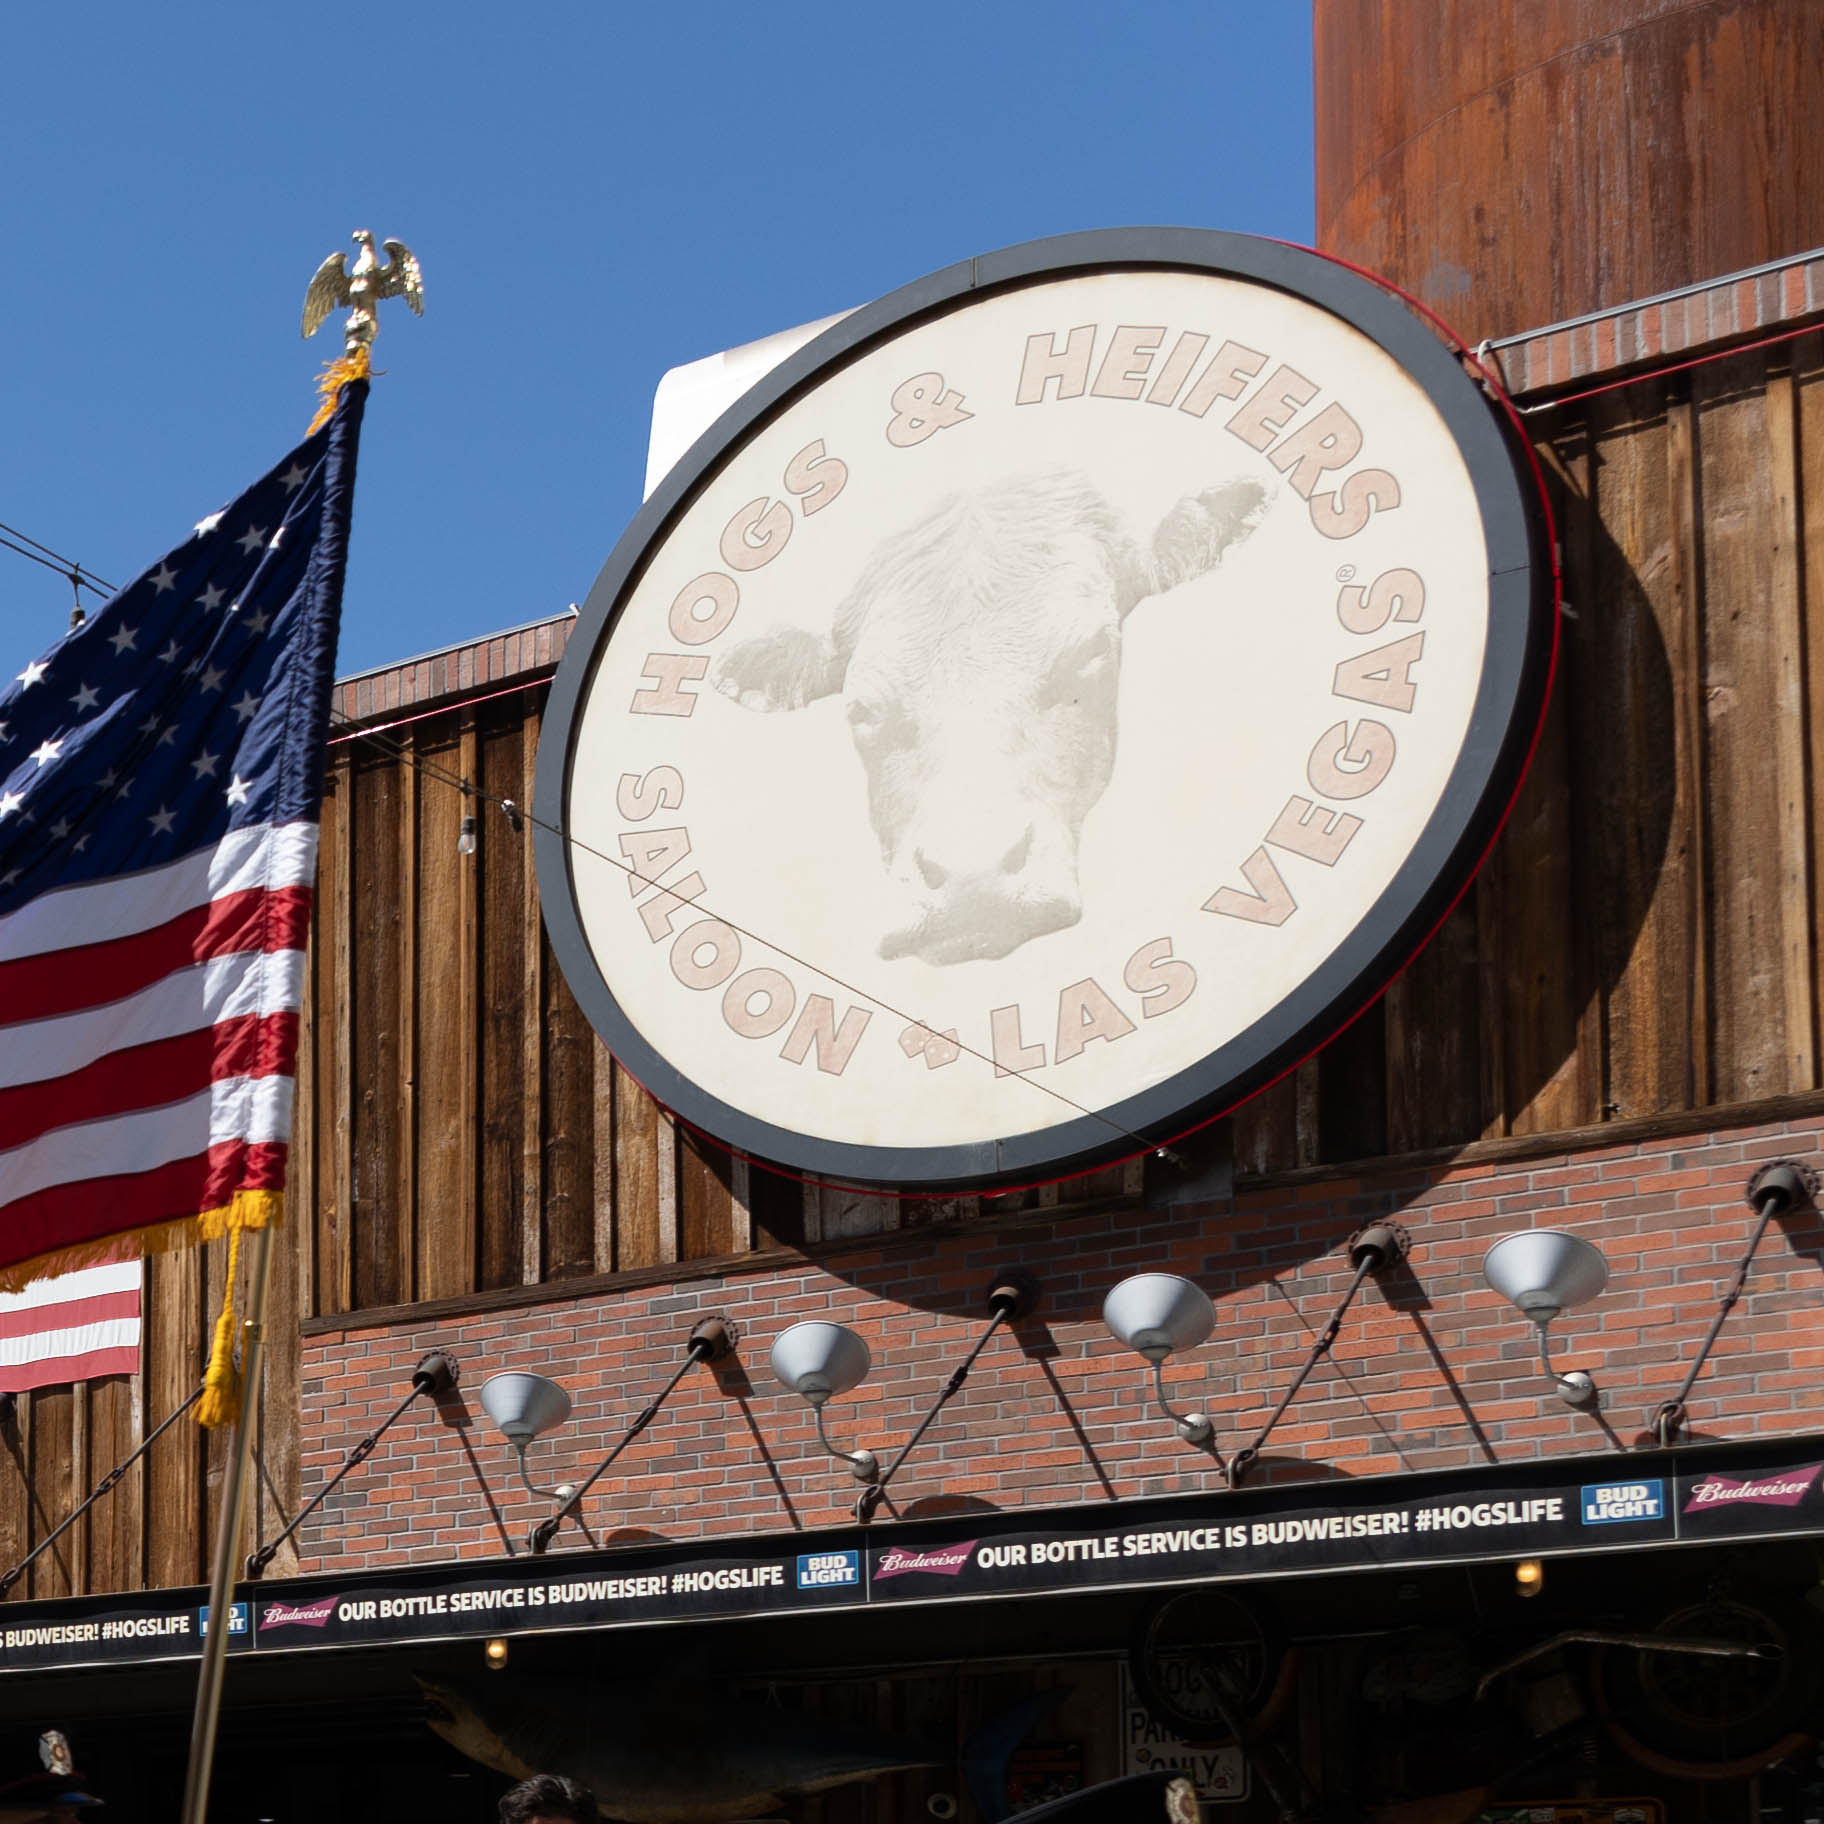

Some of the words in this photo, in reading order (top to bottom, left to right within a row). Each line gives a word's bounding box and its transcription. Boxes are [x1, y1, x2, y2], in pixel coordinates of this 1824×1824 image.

[630, 439, 849, 718] HOGS
[885, 371, 975, 449] &
[1015, 323, 1402, 542] HEIFERS
[616, 764, 874, 1078] SALOON
[992, 936, 1198, 1080] LAS
[1200, 564, 1428, 929] VEGAS
[1595, 1484, 1649, 1504] BUD
[1690, 1480, 1811, 1504] Budweiser
[1586, 1499, 1659, 1521] LIGHT
[977, 1545, 1027, 1569] OUR
[1031, 1537, 1120, 1563] BOTTLE
[1123, 1527, 1221, 1557] SERVICE
[1225, 1525, 1248, 1548] IS
[1251, 1511, 1409, 1546] BUDWEISER!
[1414, 1497, 1564, 1532] #HOGSLIFE
[807, 1555, 848, 1571] BUD
[878, 1548, 968, 1572] Budweiser
[800, 1567, 856, 1585] LIGHT
[338, 1601, 377, 1622] OUR
[380, 1594, 448, 1618] BOTTLE
[449, 1588, 525, 1613] SERVICE
[528, 1586, 546, 1606] IS
[548, 1575, 667, 1604] BUDWEISER!
[671, 1565, 784, 1594] #HOGSLIFE
[263, 1607, 332, 1624] Budweiser
[5, 1623, 99, 1648] BUDWEISER!
[101, 1615, 190, 1640] #HOGSLIFE
